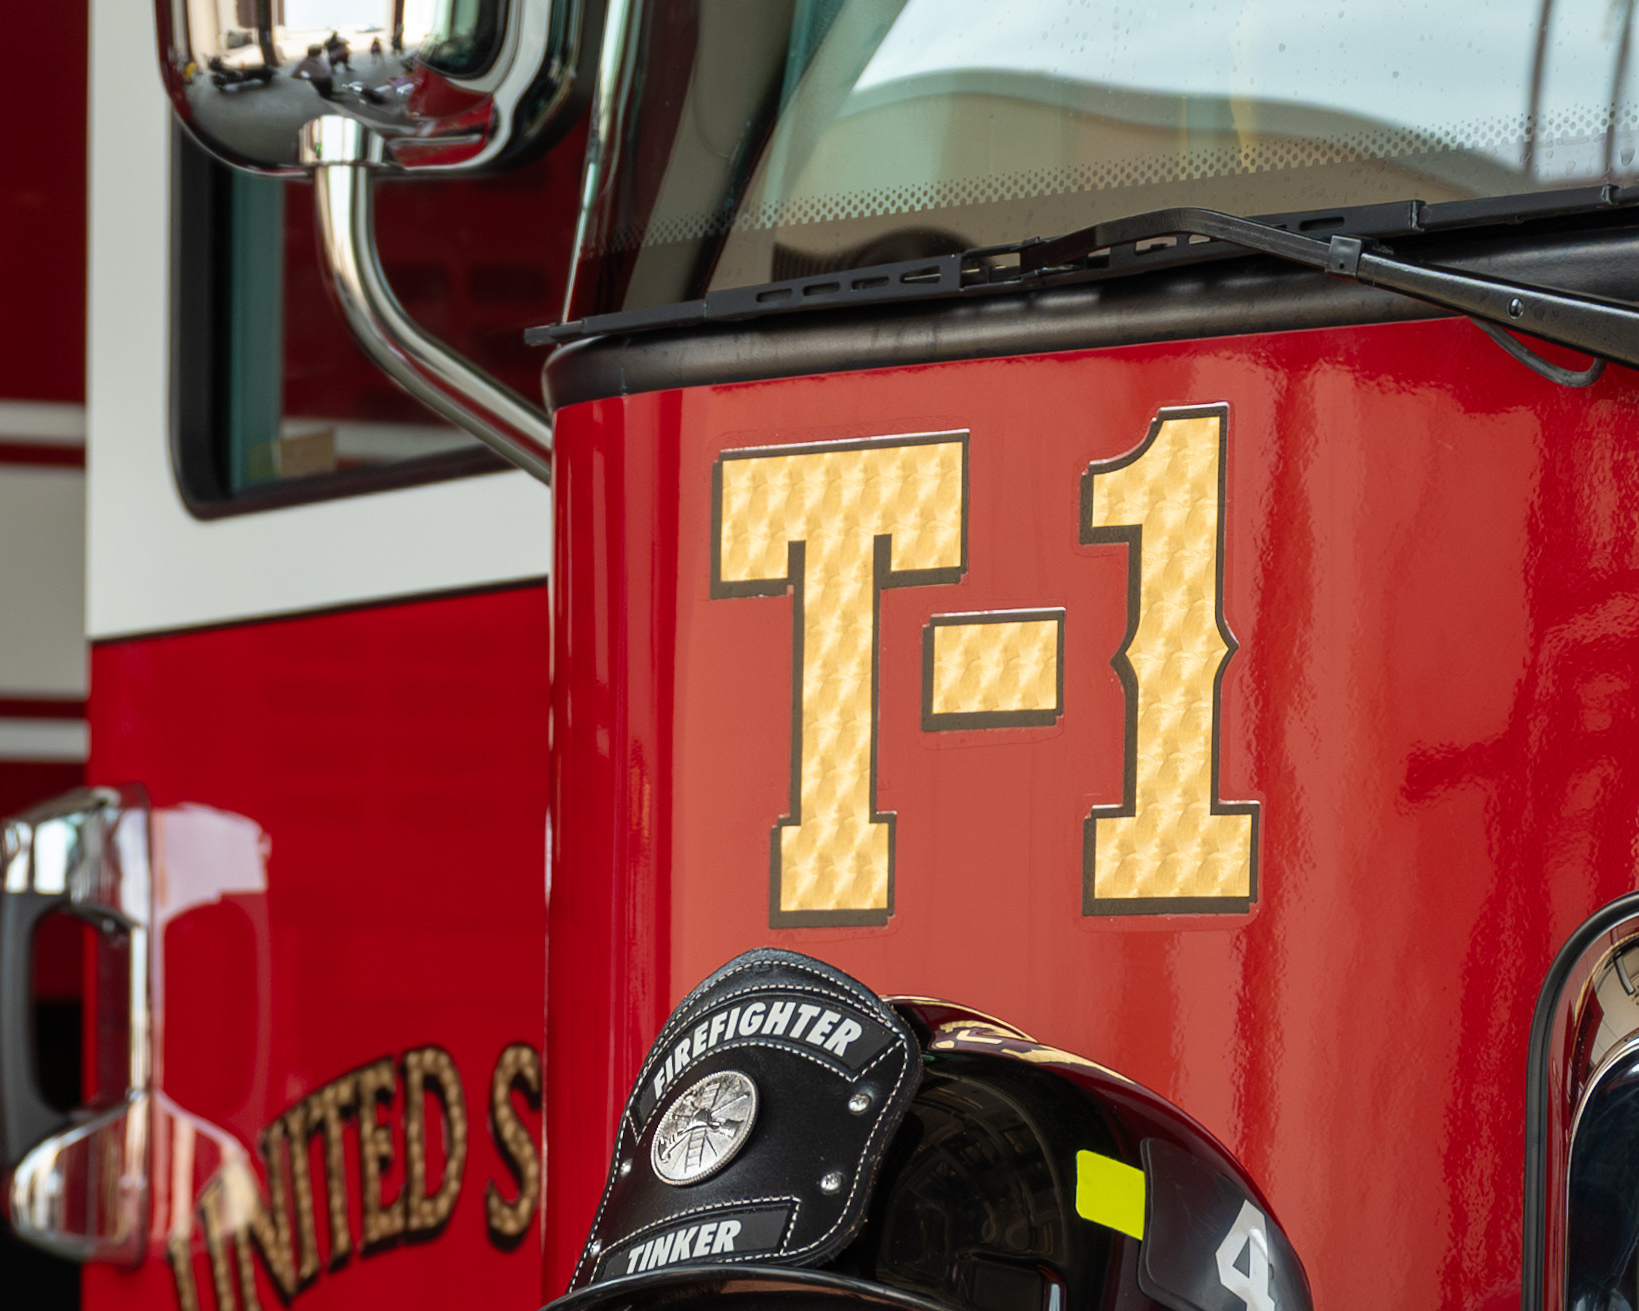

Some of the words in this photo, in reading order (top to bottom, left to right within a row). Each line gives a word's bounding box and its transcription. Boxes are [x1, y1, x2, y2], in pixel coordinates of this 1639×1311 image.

[710, 402, 1260, 928] T-1
[652, 1001, 863, 1100] FIREFIGHTER
[626, 1219, 743, 1275] TINKER
